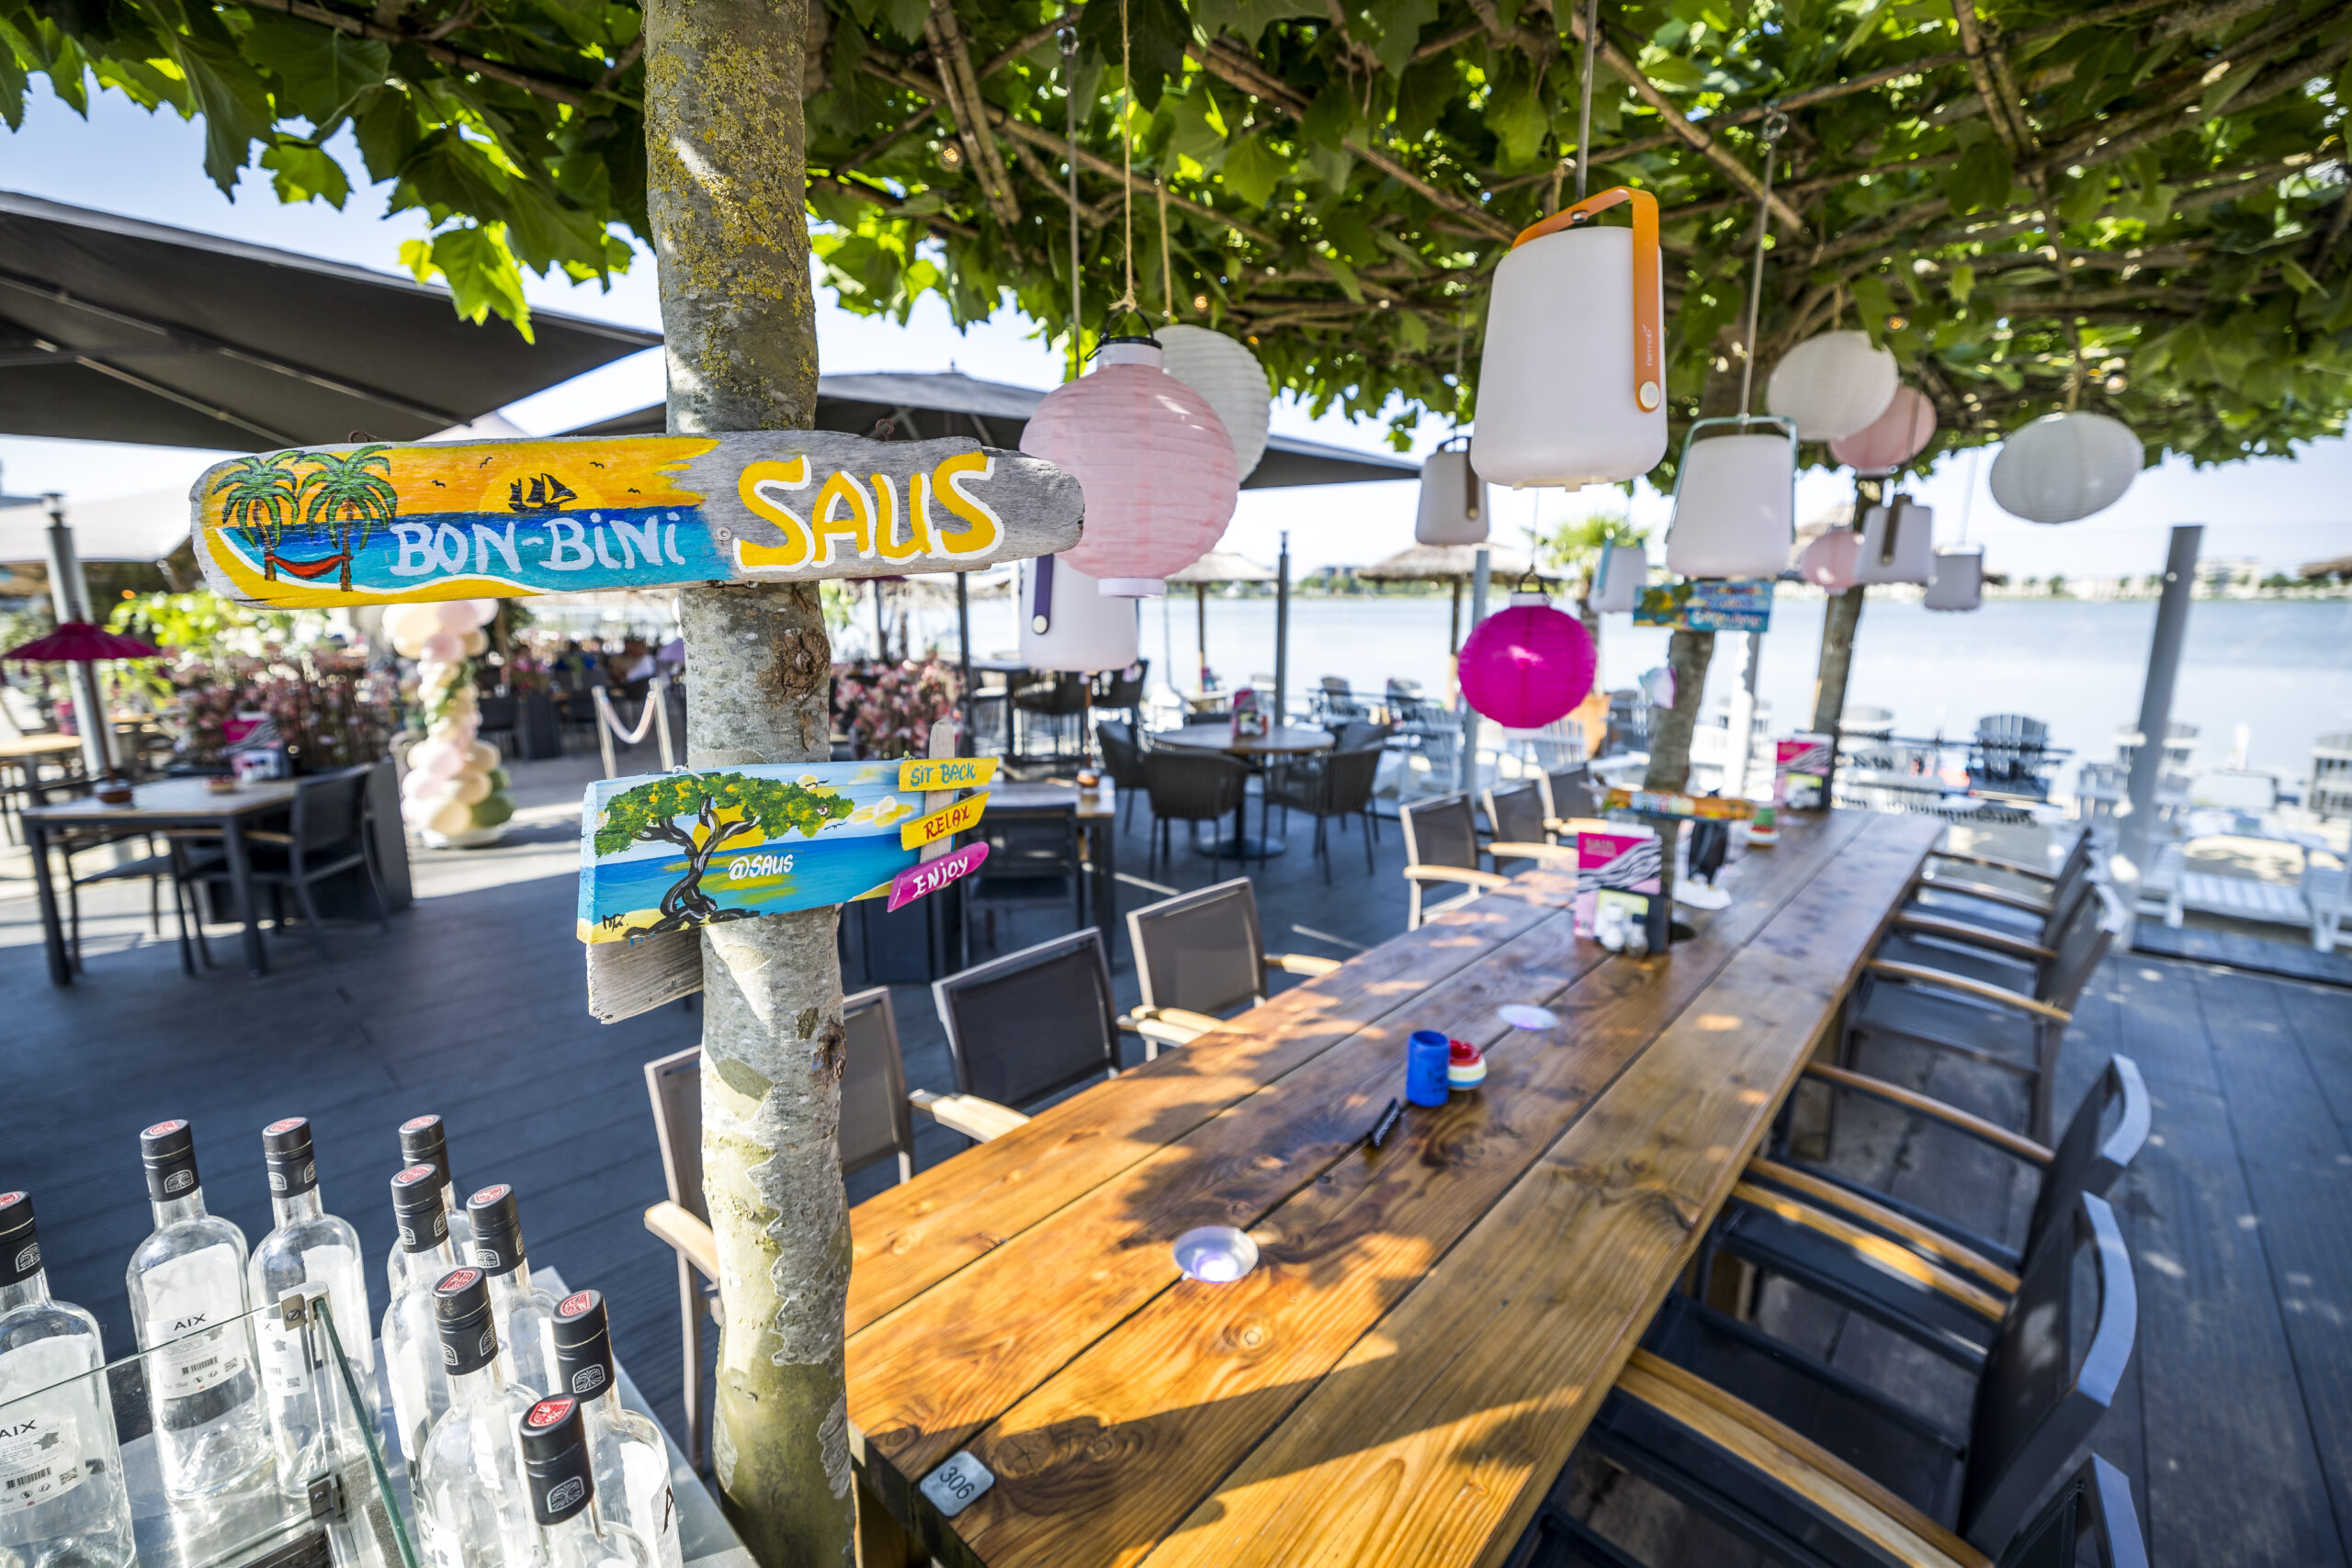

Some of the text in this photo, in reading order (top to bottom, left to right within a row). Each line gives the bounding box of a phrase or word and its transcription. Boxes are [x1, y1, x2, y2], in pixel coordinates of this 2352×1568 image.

[731, 451, 1005, 573] SAUS
[939, 762, 977, 784] BACK
[923, 806, 971, 840] RELAX
[729, 854, 794, 880] @SAUS
[174, 1314, 207, 1331] AIX
[0, 1419, 37, 1438] AIX
[940, 1467, 975, 1499] 306
